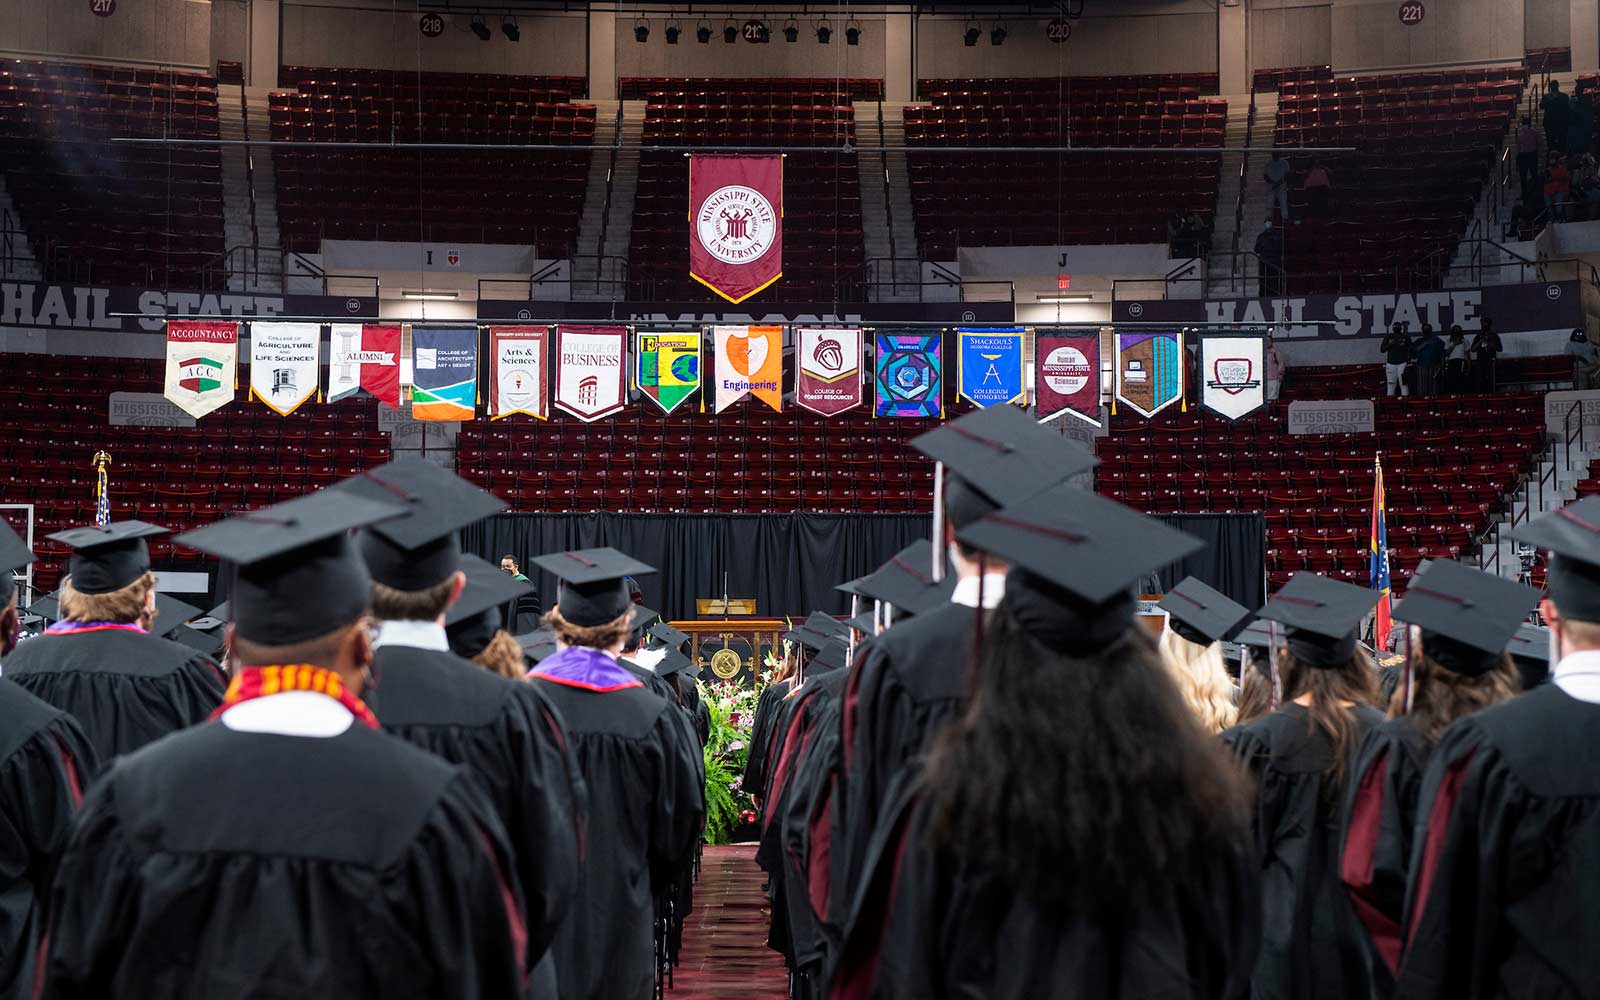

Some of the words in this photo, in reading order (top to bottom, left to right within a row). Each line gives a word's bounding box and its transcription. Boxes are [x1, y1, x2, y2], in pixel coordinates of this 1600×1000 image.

[94, 0, 111, 13] 217
[1402, 7, 1421, 20] 221
[423, 19, 440, 33] 218
[1049, 25, 1069, 38] 220
[703, 191, 750, 222] MISSISSIPPI
[751, 197, 771, 225] STATE
[710, 239, 762, 259] UNIVERSITY
[1058, 253, 1068, 267] J
[0, 283, 122, 329] HAIL
[138, 291, 284, 330] STATE
[1204, 298, 1319, 338] HAIL
[1334, 290, 1481, 336] STATE
[170, 329, 234, 339] ACCOUNTANCY
[505, 348, 522, 356] Arts
[524, 348, 533, 356] &
[563, 343, 605, 353] COLLEGE
[607, 344, 619, 353] OF
[347, 353, 383, 361] ALUMNI
[502, 356, 536, 365] Sciences
[563, 354, 619, 367] BUSINESS
[1042, 364, 1074, 372] MISSISSIPPI
[1075, 364, 1092, 372] STATE
[723, 380, 777, 391] Engineering
[1055, 377, 1079, 385] Sciences
[1292, 411, 1371, 423] MISSISSIPPI
